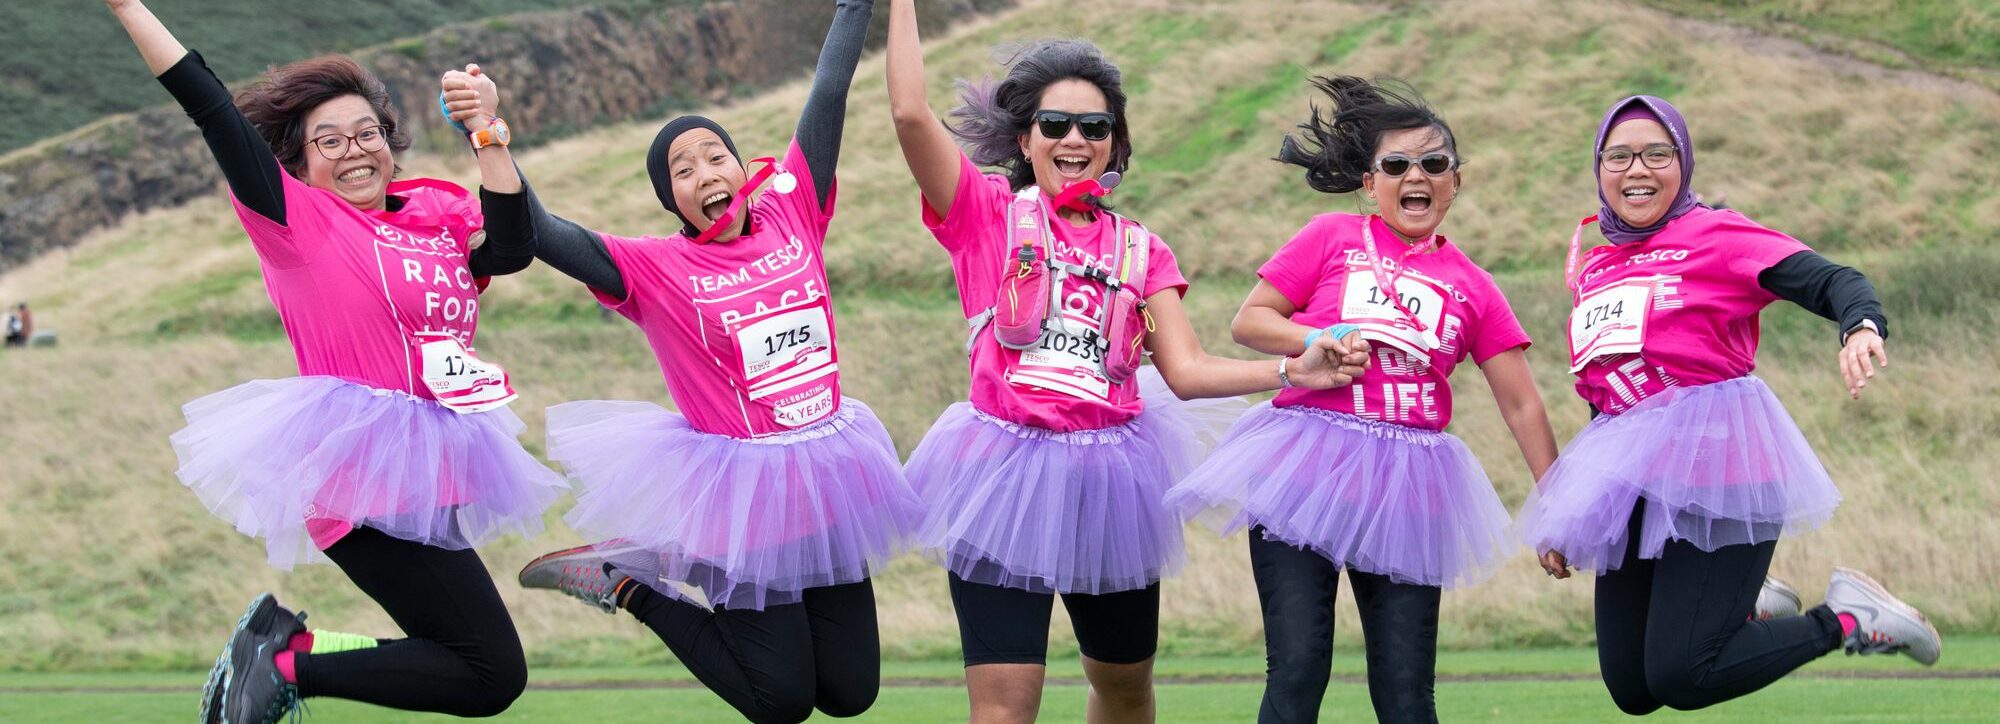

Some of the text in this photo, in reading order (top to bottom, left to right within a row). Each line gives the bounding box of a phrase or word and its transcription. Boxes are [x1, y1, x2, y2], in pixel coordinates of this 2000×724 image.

[402, 259, 473, 291] RAC
[689, 235, 803, 294] TEAM TESCO
[425, 291, 476, 323] FOR
[1585, 301, 1623, 330] 1714
[764, 325, 811, 356] 1715
[1377, 347, 1431, 377] OR
[774, 384, 825, 407] CELEBRATING
[797, 395, 832, 418] YEARS
[1352, 382, 1438, 421] LIFE
